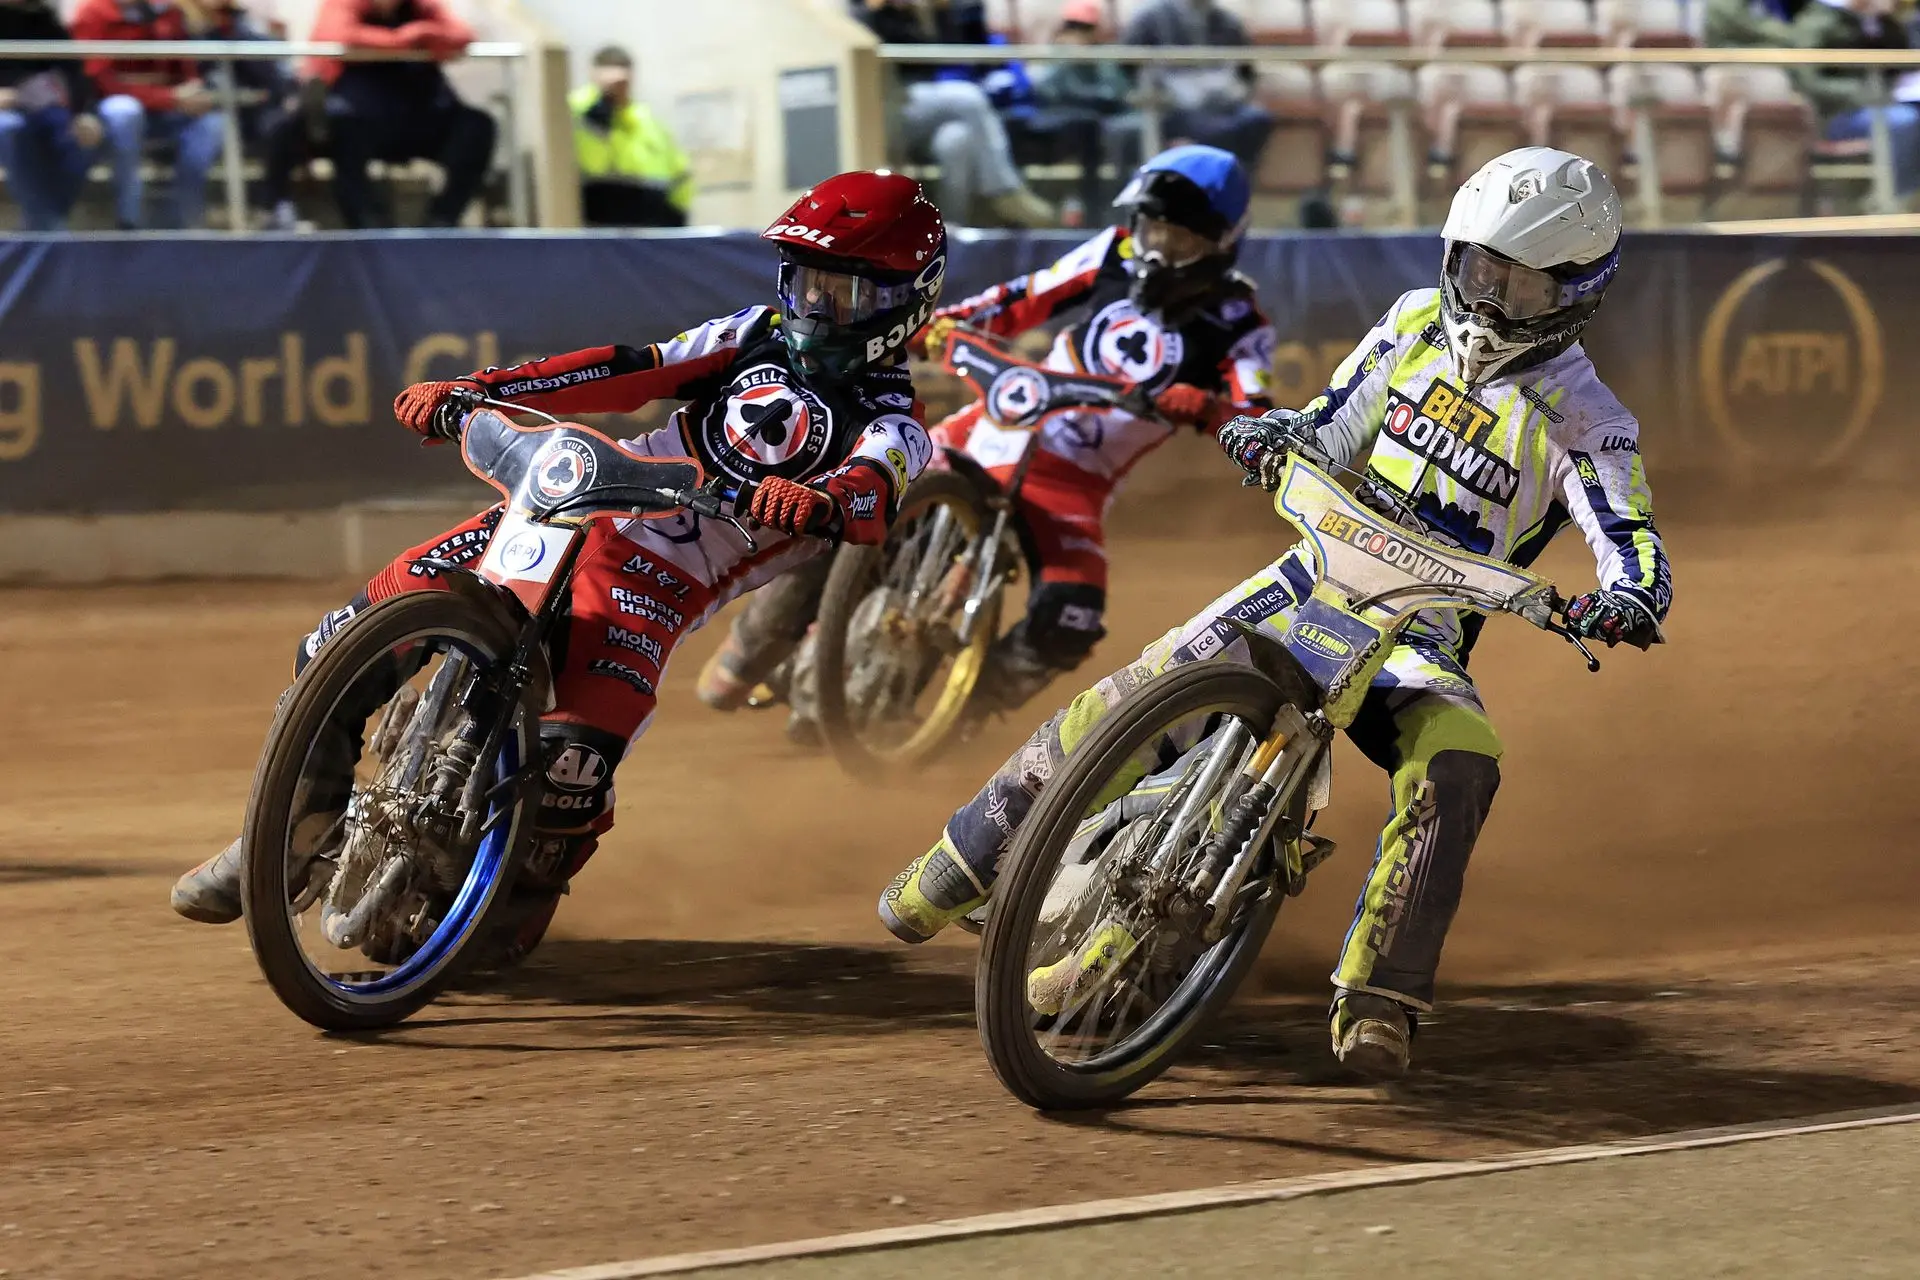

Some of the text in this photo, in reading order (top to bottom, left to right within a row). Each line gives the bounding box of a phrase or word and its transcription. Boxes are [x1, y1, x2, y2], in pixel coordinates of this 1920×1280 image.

[763, 225, 835, 249] BOLL
[866, 303, 928, 363] BOLL
[72, 331, 371, 430] World
[740, 370, 788, 389] BELLE
[807, 413, 825, 454] ACES
[1297, 411, 1316, 424] FIST
[1421, 385, 1493, 443] BET
[566, 441, 584, 453] VUE
[581, 452, 593, 473] ACES
[410, 529, 491, 576] ESTERN
[1318, 511, 1463, 585] BETGOODWIN
[611, 587, 683, 626] Richard
[620, 602, 675, 633] Hayes
[1260, 598, 1290, 617] Australia
[607, 626, 662, 660] Mobil
[1192, 634, 1216, 656] Ice
[541, 793, 593, 810] BOLL
